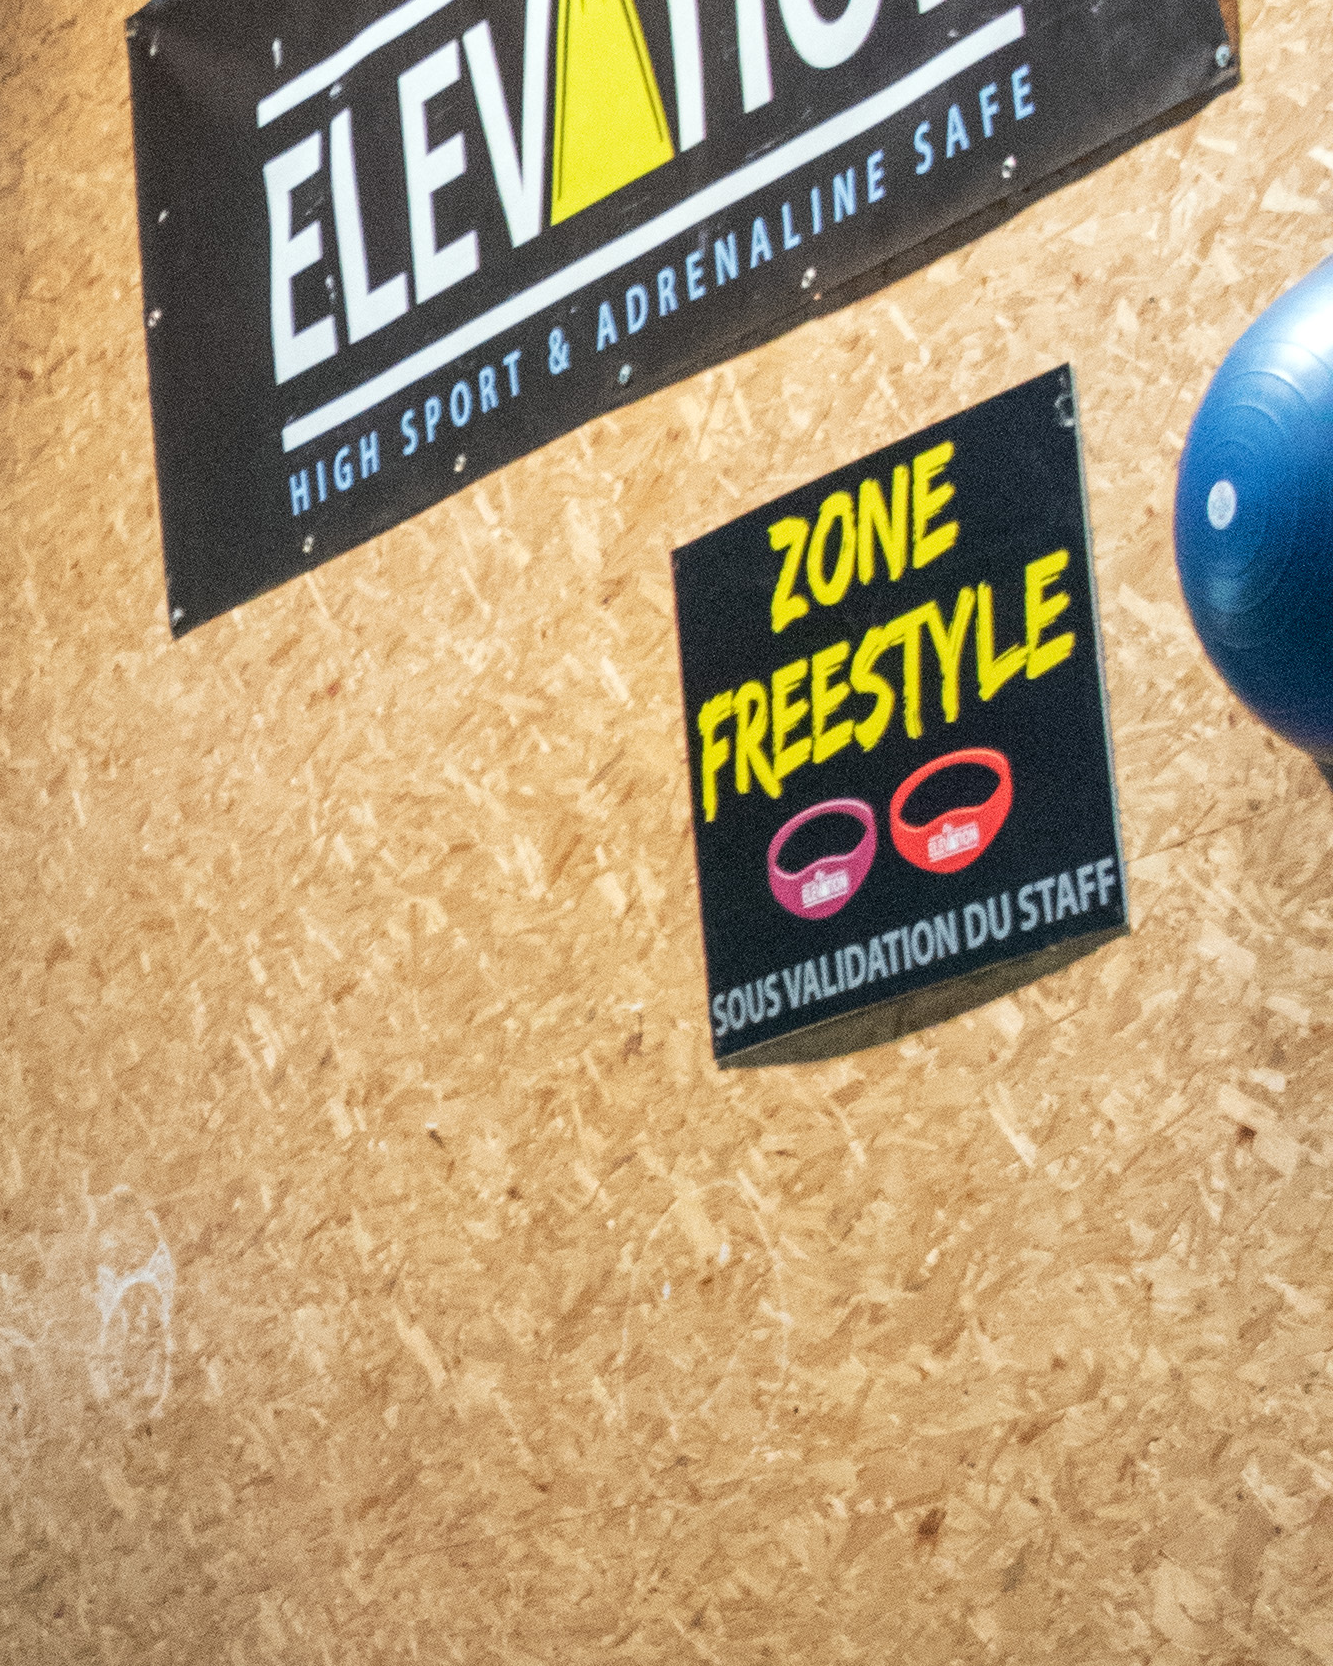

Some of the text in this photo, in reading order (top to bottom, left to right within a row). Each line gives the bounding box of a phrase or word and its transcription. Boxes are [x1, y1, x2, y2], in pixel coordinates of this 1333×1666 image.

[287, 65, 1039, 516] HIGH SPORT & ADRENALINE SAFE
[768, 440, 960, 633] ZONE
[698, 548, 1076, 823] FREESTYLE
[712, 856, 1118, 1037] SOUS VALIDATION DU STAFF
